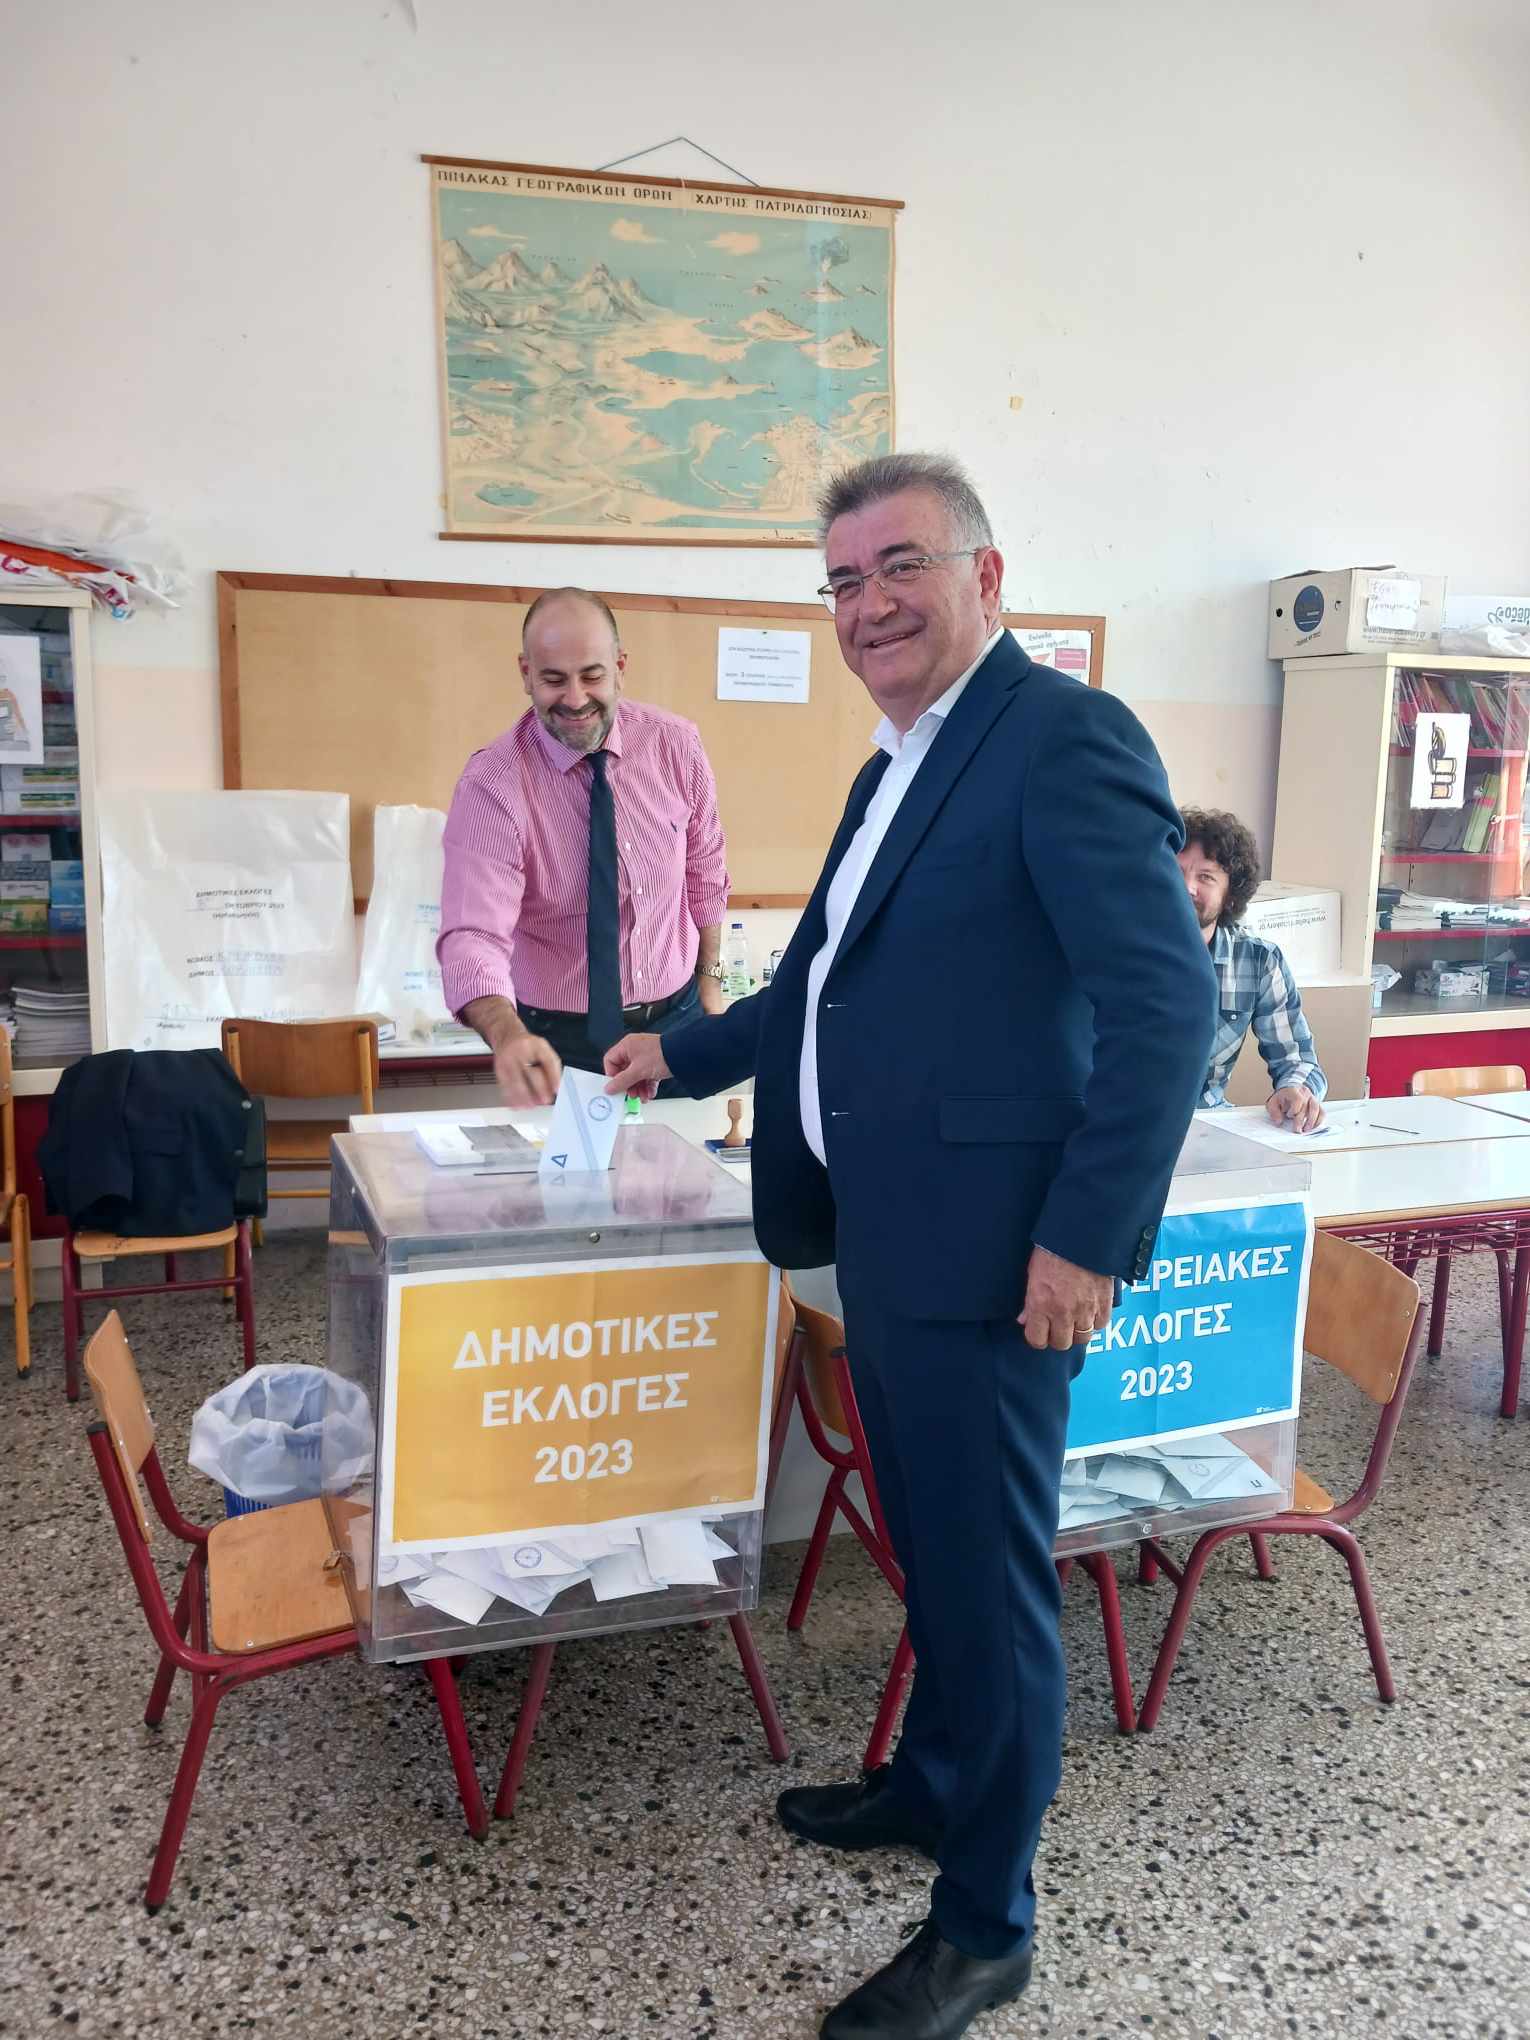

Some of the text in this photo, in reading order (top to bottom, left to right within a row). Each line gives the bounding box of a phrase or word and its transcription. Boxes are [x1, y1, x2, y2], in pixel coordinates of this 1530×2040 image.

[438, 170, 509, 186] ΠΙΝΑΚΑΣ
[453, 1311, 719, 1369] ΔΗΜΟΤΙΚΕΣ
[481, 1373, 689, 1427] ΕΚΛΟΓΕΣ
[1120, 1360, 1193, 1401] 2023
[534, 1439, 633, 1483] 2023
